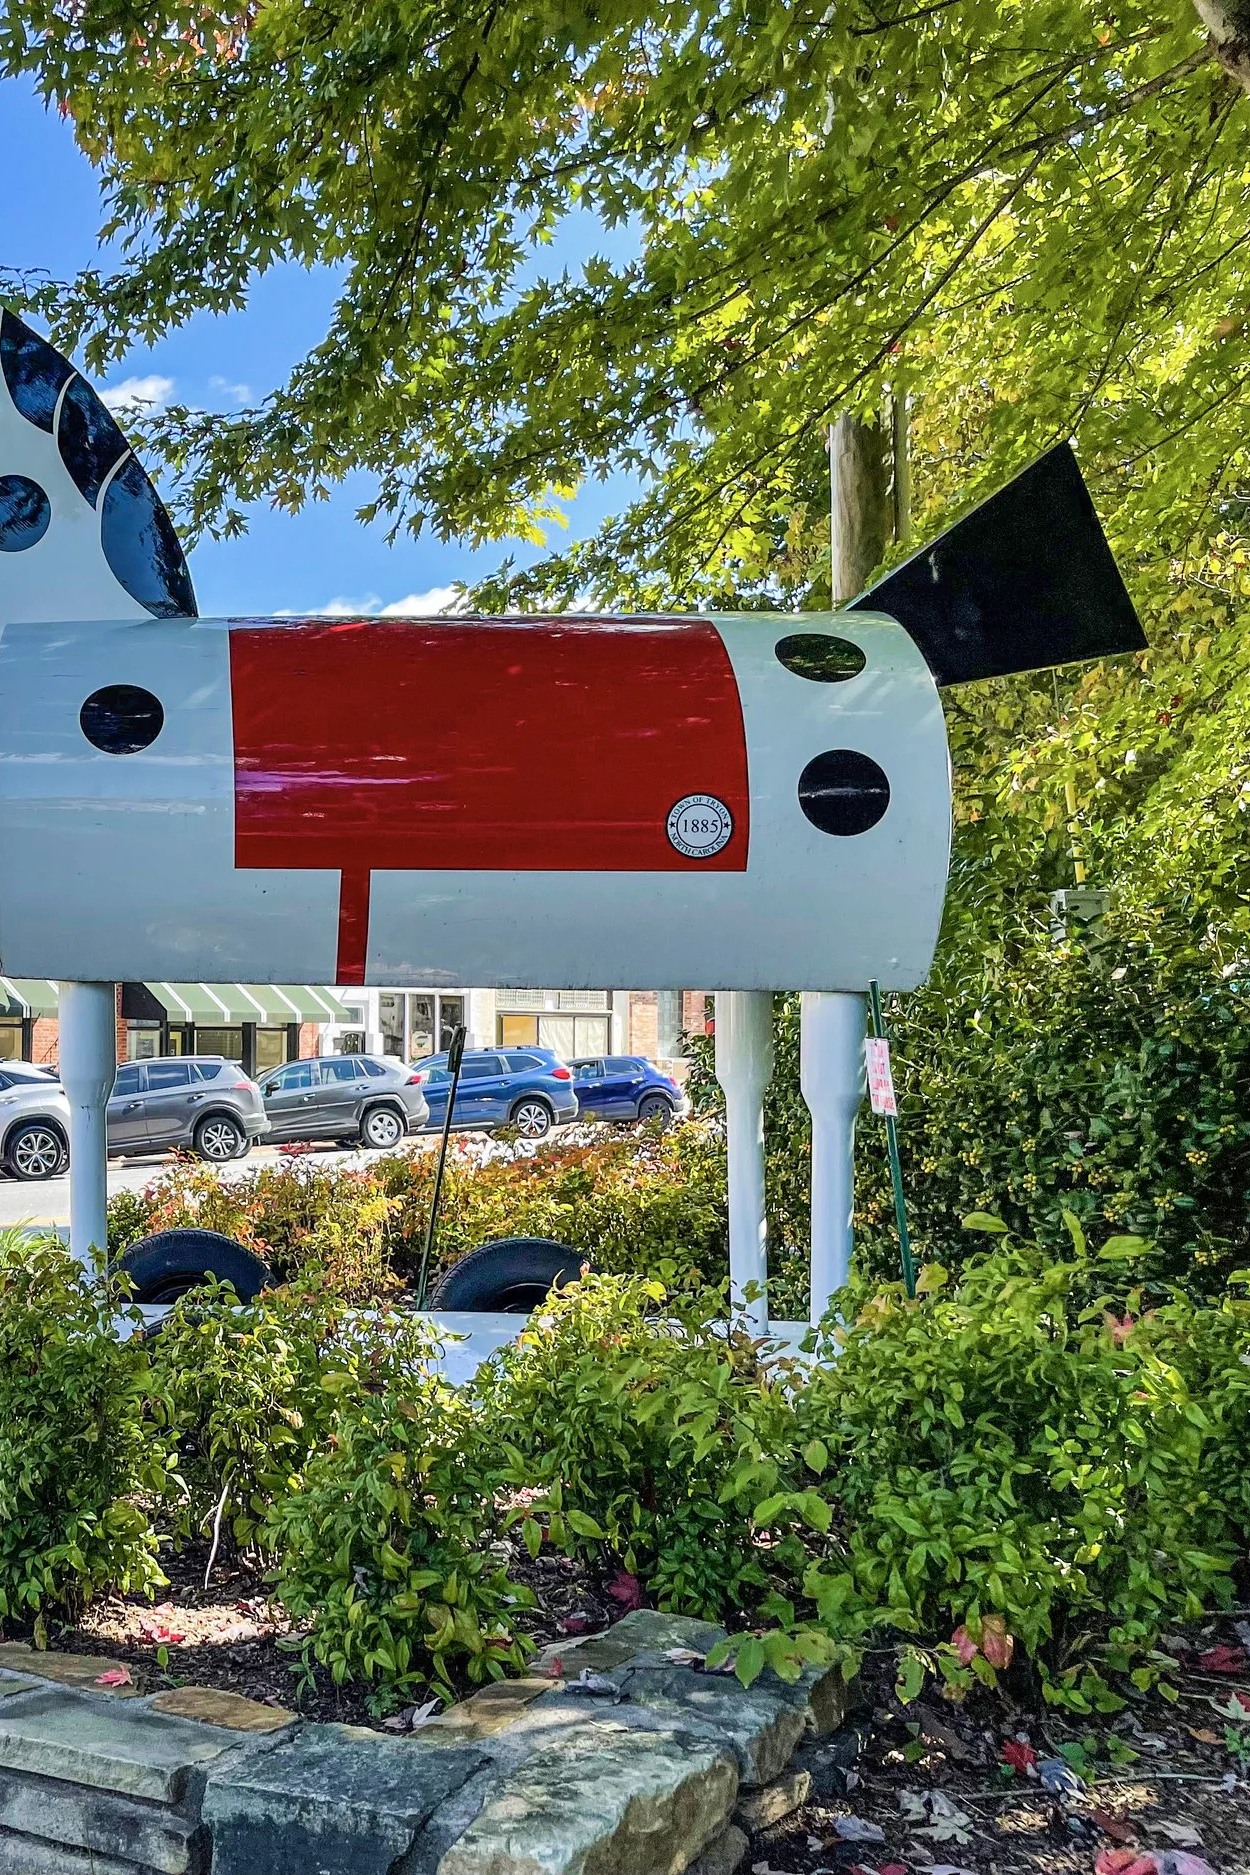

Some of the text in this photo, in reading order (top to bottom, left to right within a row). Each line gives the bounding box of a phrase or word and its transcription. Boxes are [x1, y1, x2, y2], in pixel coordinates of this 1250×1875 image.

[671, 800, 691, 819] TOWN
[706, 798, 729, 820] TRYON
[683, 819, 719, 833] 1885
[671, 832, 729, 855] NORTH CAROLINA
